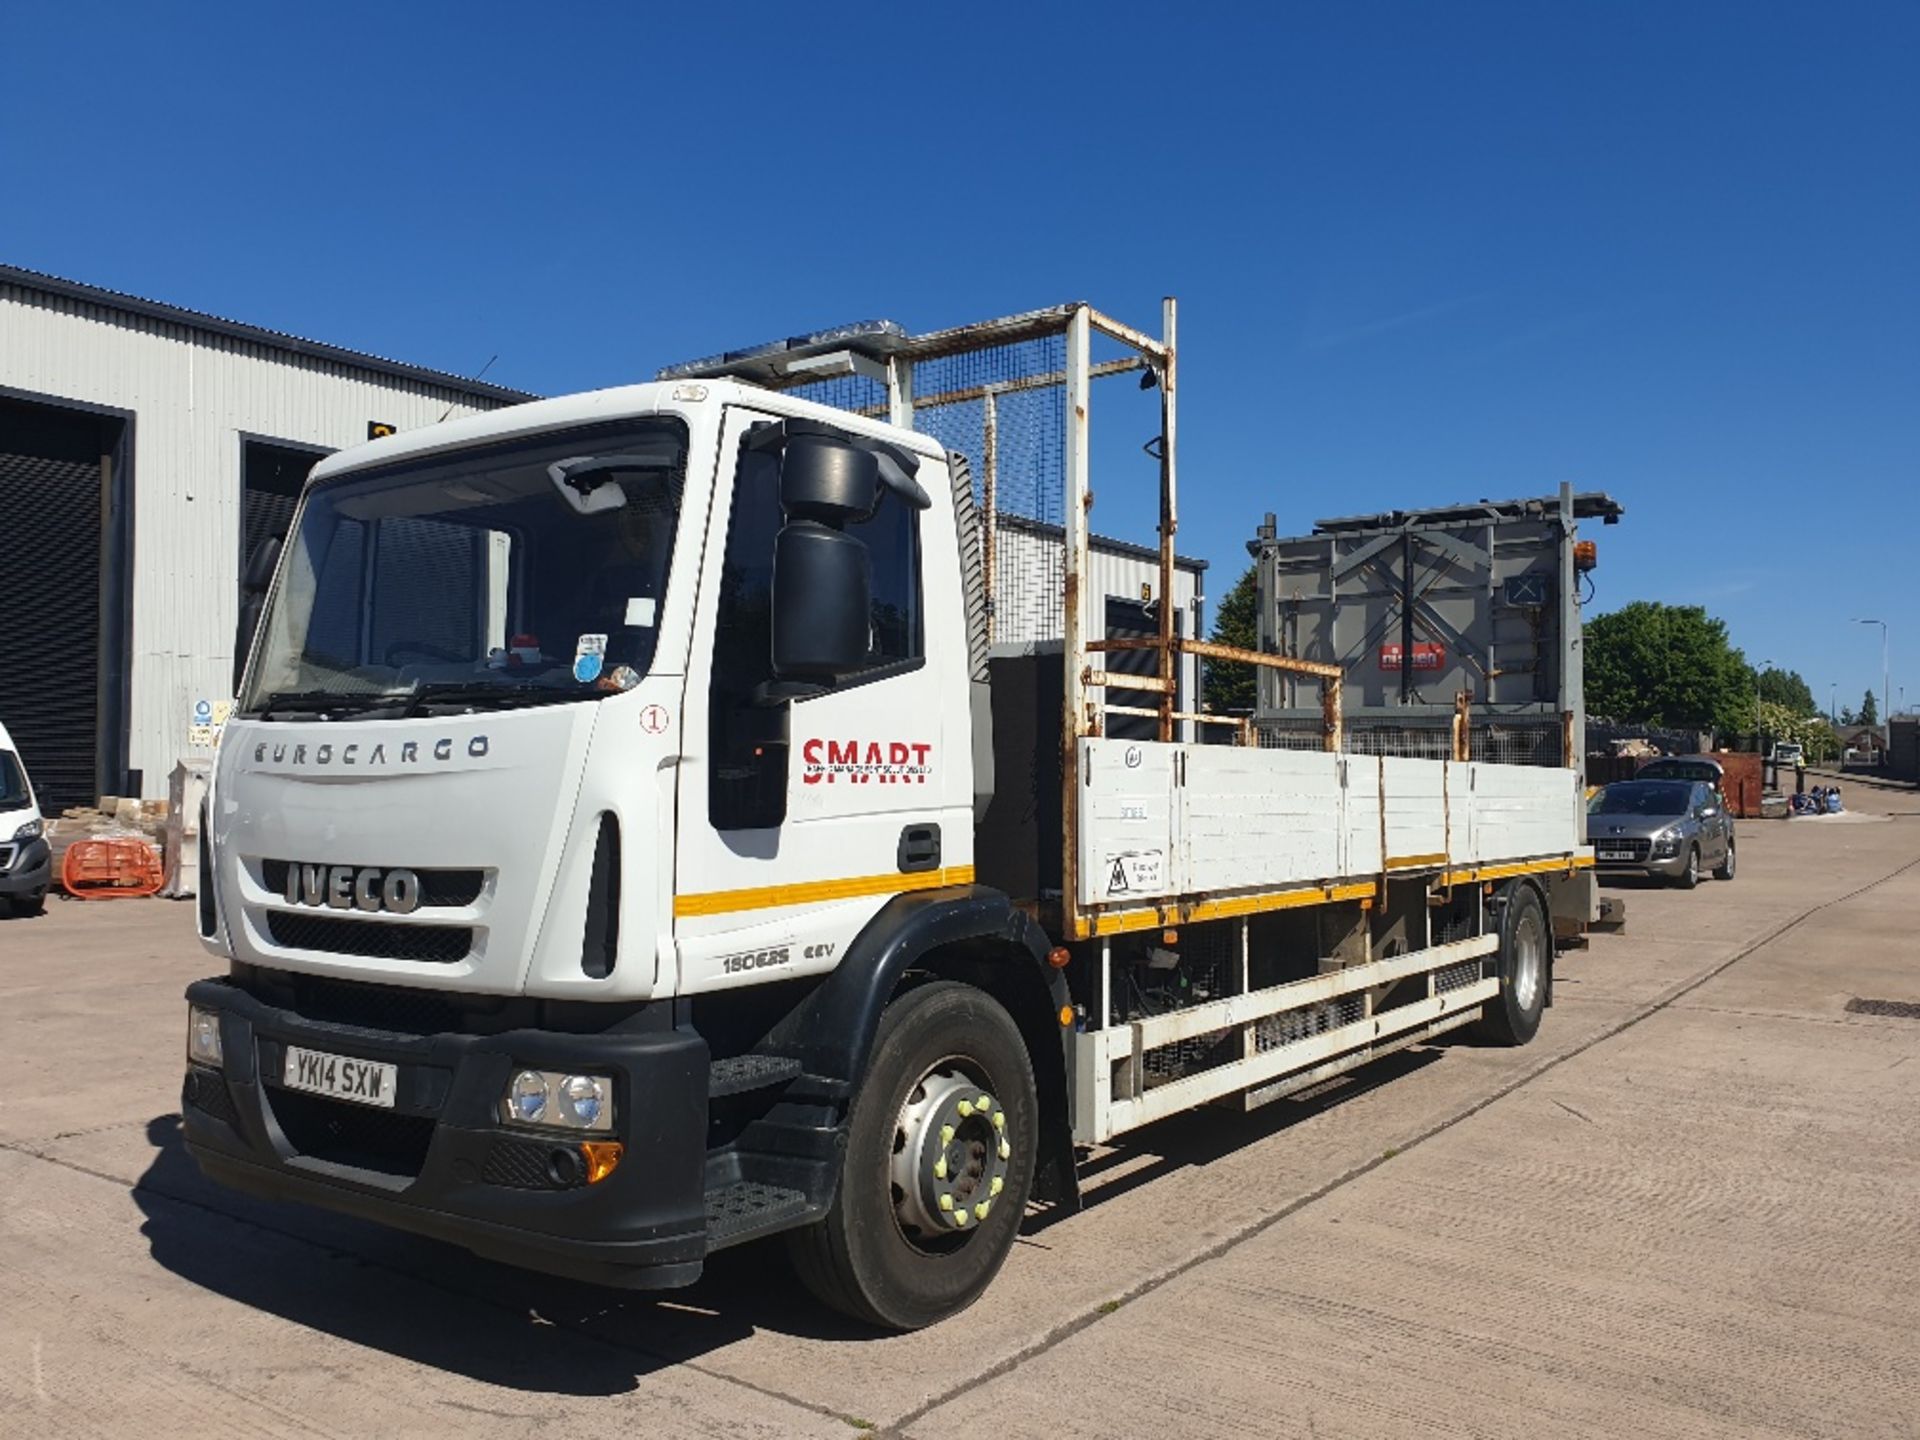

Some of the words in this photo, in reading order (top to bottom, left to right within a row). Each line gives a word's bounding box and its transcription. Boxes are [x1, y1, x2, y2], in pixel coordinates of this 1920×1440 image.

[649, 709, 660, 730] 1
[254, 735, 489, 765] EUROCARGO
[803, 738, 934, 785] SMART
[284, 862, 419, 914] IVECO
[298, 1052, 336, 1092] YK14
[341, 1062, 383, 1098] SXW
